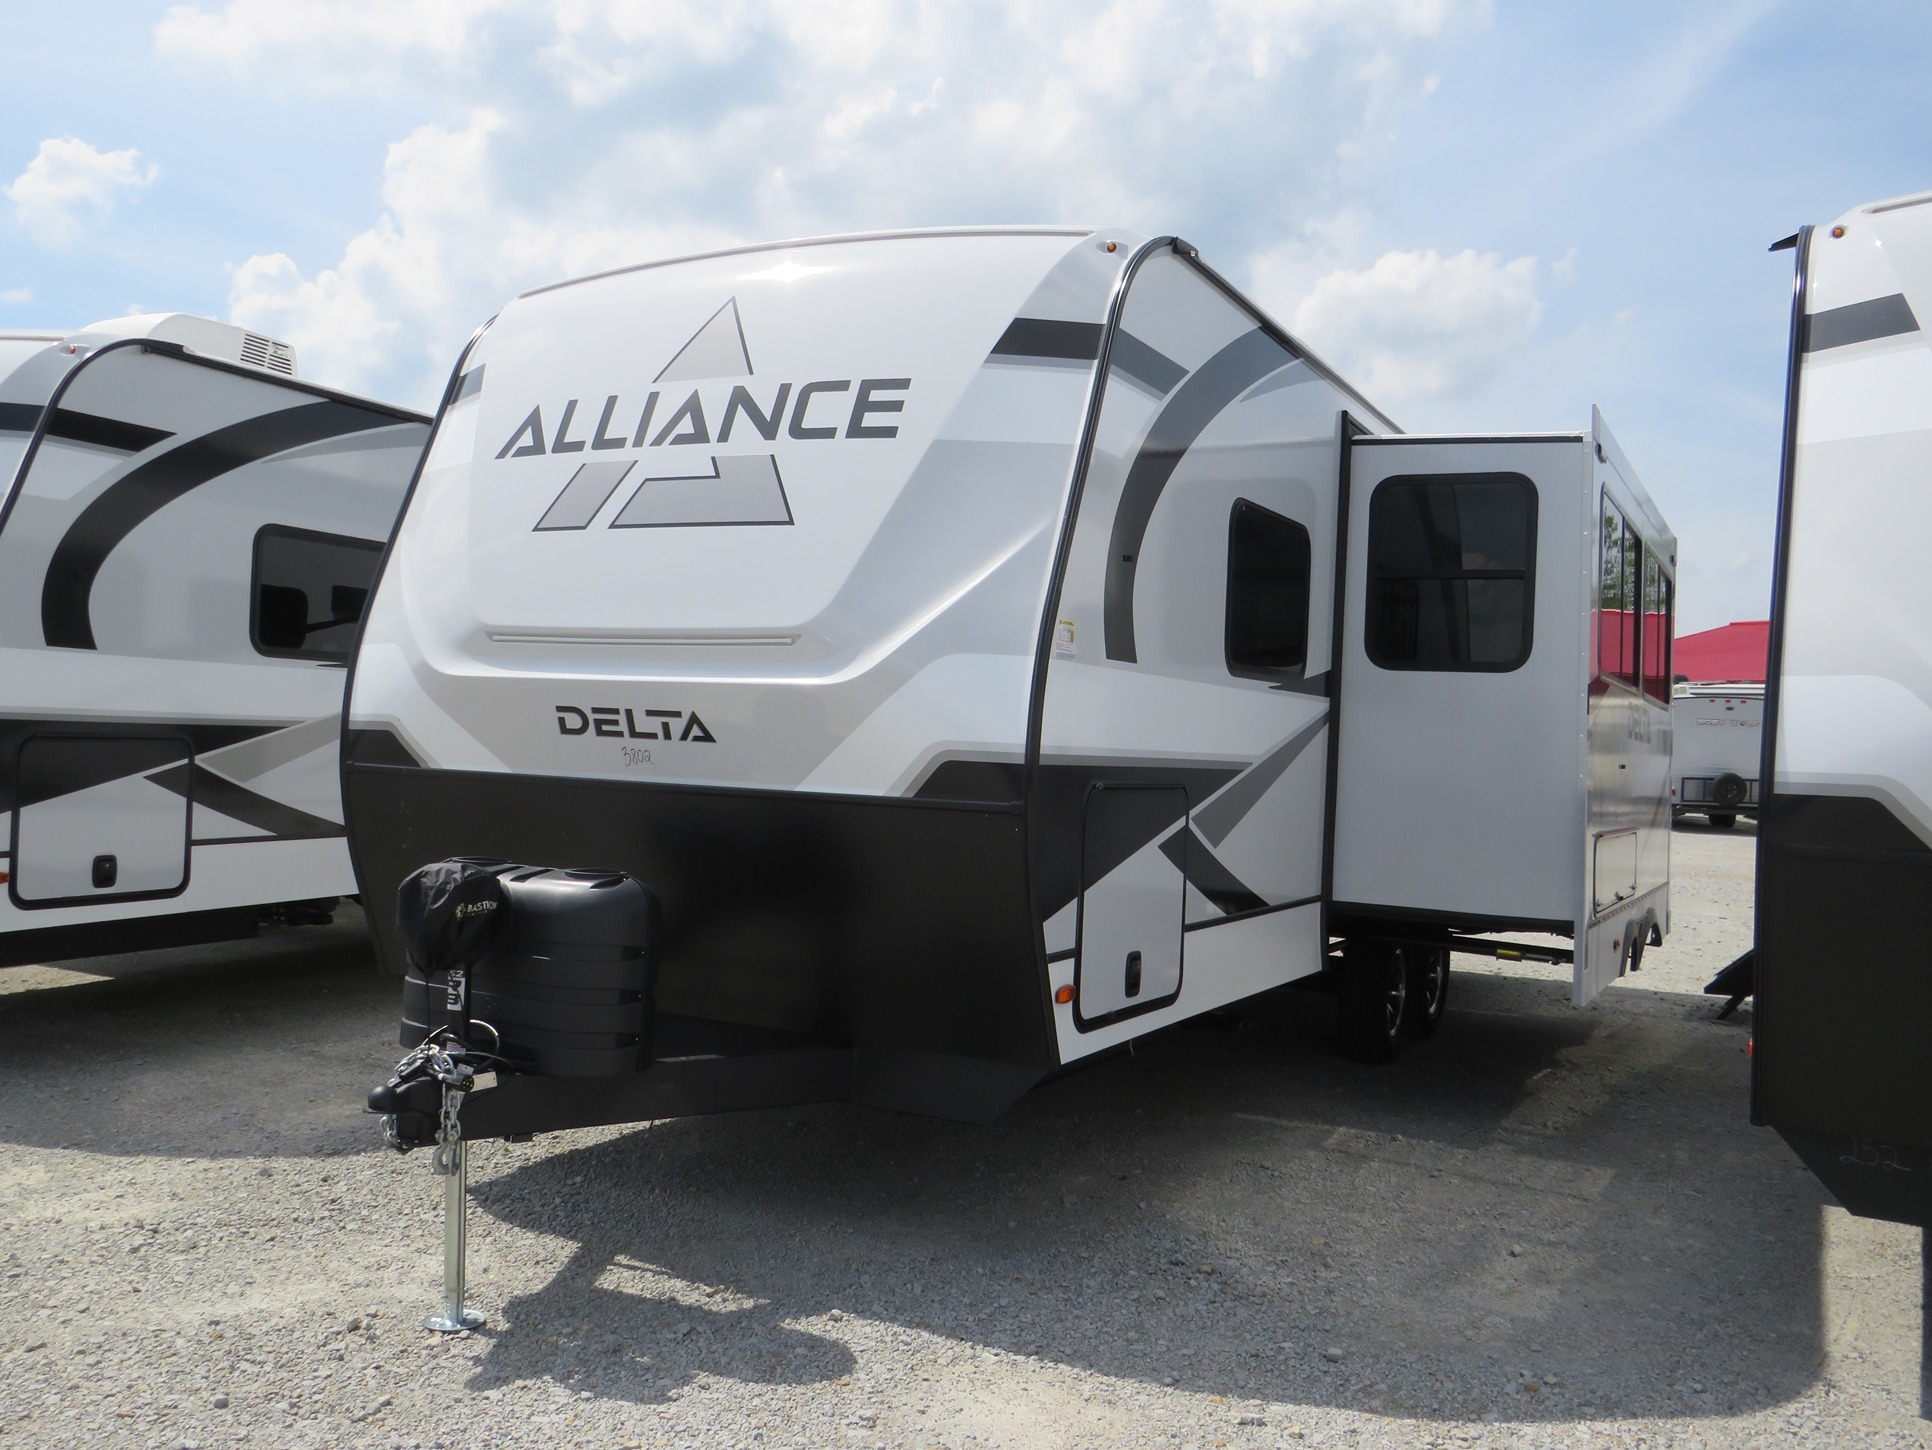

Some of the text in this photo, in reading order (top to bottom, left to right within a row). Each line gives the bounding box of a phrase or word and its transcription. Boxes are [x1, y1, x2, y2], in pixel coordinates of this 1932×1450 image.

[494, 377, 912, 460] ALLIANCE
[555, 705, 717, 743] DELTA
[621, 746, 654, 768] 3802
